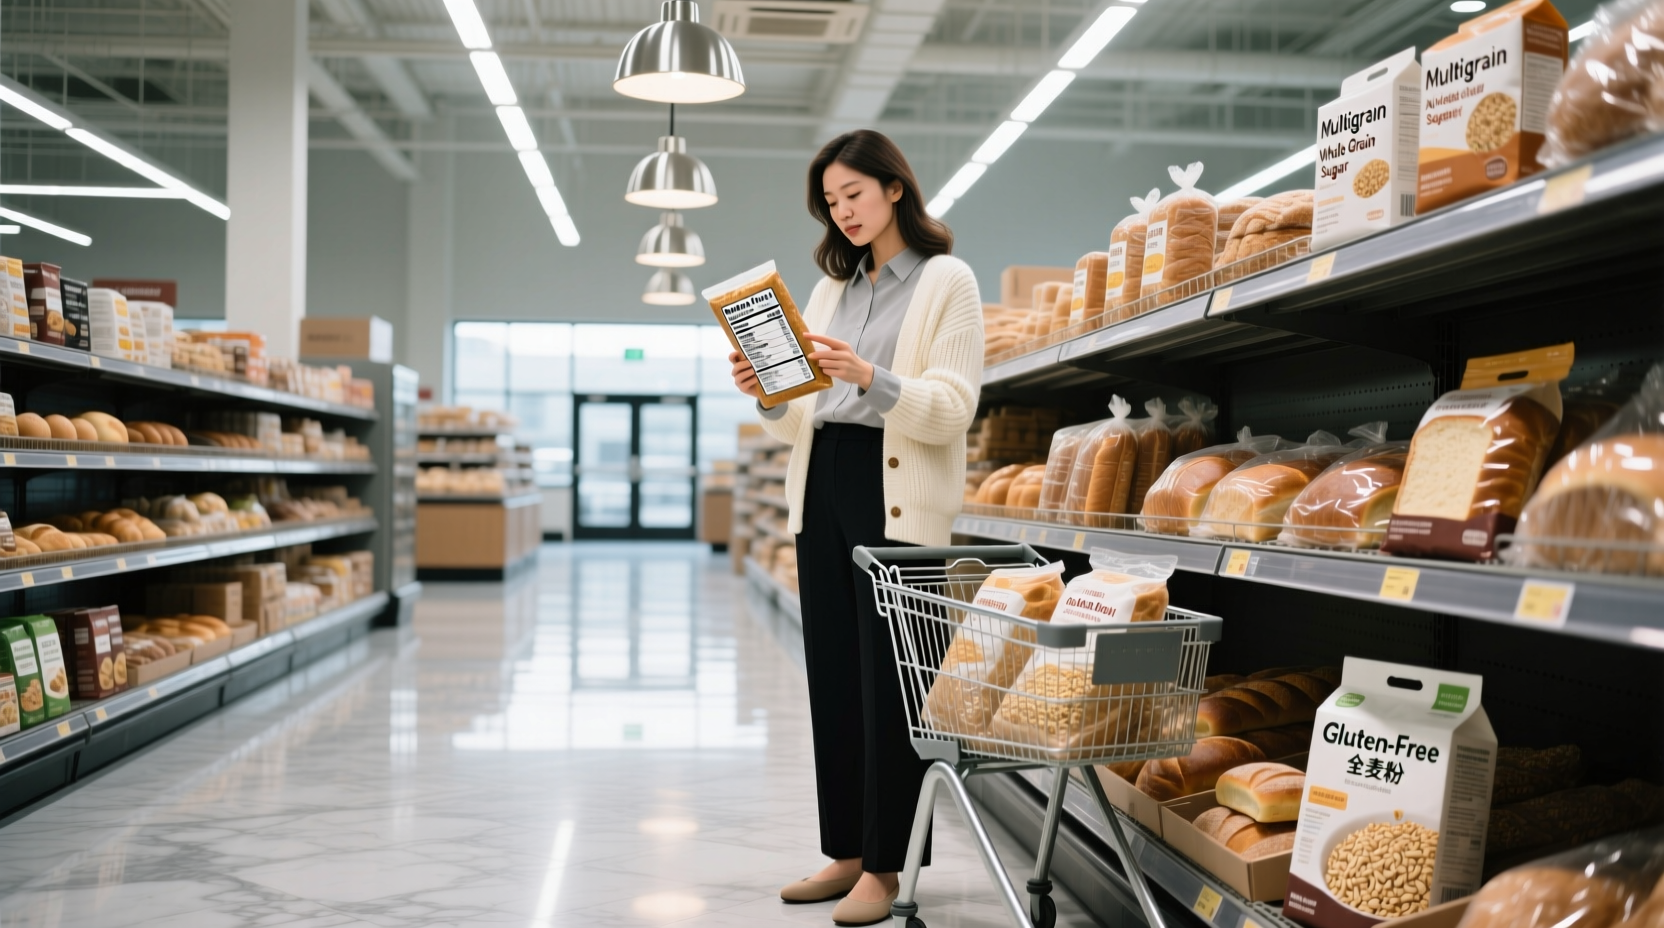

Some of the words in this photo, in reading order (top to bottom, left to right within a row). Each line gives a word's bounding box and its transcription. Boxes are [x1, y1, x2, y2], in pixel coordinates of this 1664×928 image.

[1425, 45, 1507, 91] Multigrain
[1322, 721, 1440, 764] Gluten-Free
[1346, 753, 1405, 785] 全麦粉
